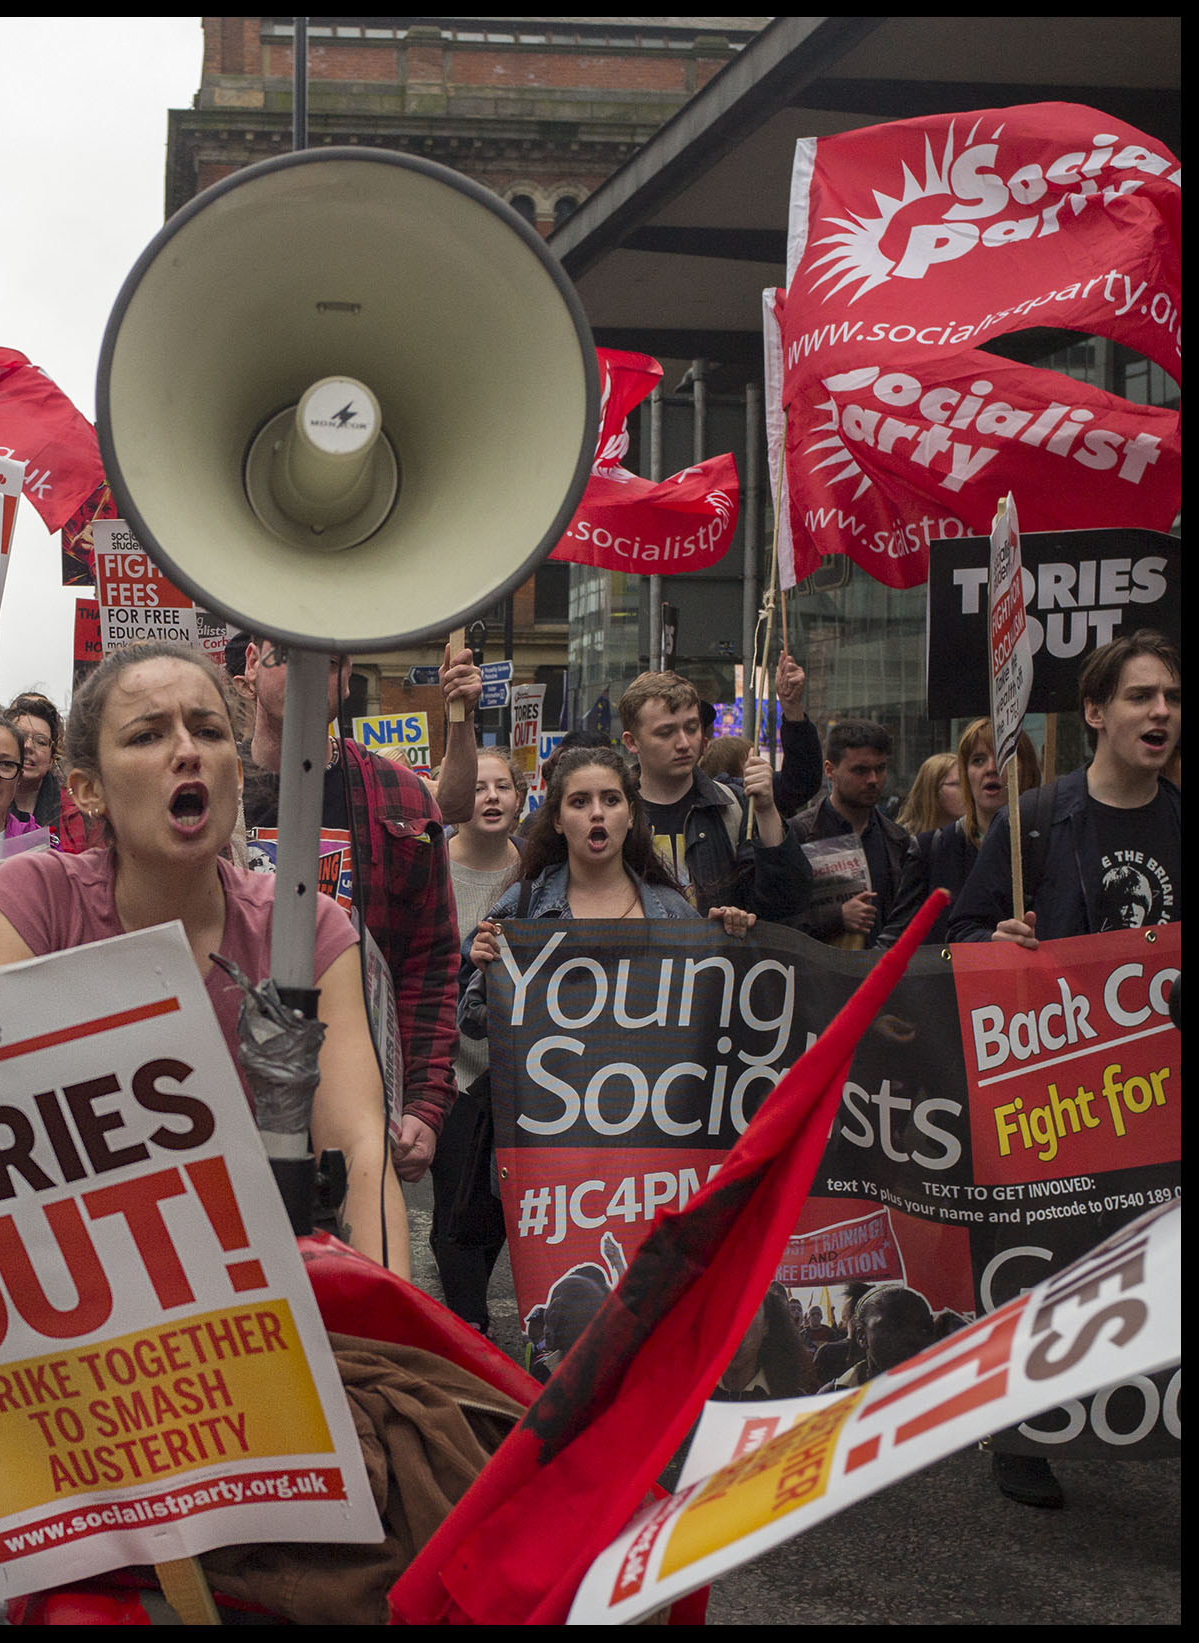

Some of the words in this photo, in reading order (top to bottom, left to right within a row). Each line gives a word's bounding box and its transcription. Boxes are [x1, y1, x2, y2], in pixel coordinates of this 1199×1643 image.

[841, 404, 999, 492] arty
[104, 554, 164, 579] FIGH
[106, 583, 160, 607] FEES
[108, 608, 140, 625] FOR
[144, 609, 180, 625] FREE
[109, 626, 190, 642] EDUCATION
[362, 716, 422, 746] NHS
[513, 720, 538, 747] OUT!
[1114, 849, 1144, 864] THE
[1145, 857, 1174, 907] BRIAN
[498, 930, 796, 1067] Young
[971, 977, 1098, 1074] Back
[994, 1083, 1101, 1163] Fight
[1101, 1064, 1171, 1138] for
[827, 1177, 858, 1194] text
[861, 1180, 878, 1196] YS
[880, 1187, 903, 1208] plus
[904, 1199, 936, 1219] your
[939, 1205, 984, 1223] name
[988, 1209, 1021, 1224] and
[1026, 1202, 1087, 1226] postcode
[1088, 1200, 1103, 1214] to
[1103, 1193, 1144, 1211] 07540
[1148, 1188, 1173, 1204] 189
[922, 1181, 960, 1200] TEXT
[964, 1187, 987, 1201] TO
[992, 1185, 1026, 1201] GET
[1028, 1177, 1097, 1199] INVOLVED:
[800, 1248, 888, 1281] EDUCATION
[809, 1251, 839, 1264] AND
[81, 1310, 288, 1388] TOGETHER
[30, 1406, 84, 1448] TO
[87, 1370, 233, 1438] SMASH
[51, 1412, 250, 1494] AUSTERITY
[4, 1472, 328, 1554] www.socialistparty.org.uk
